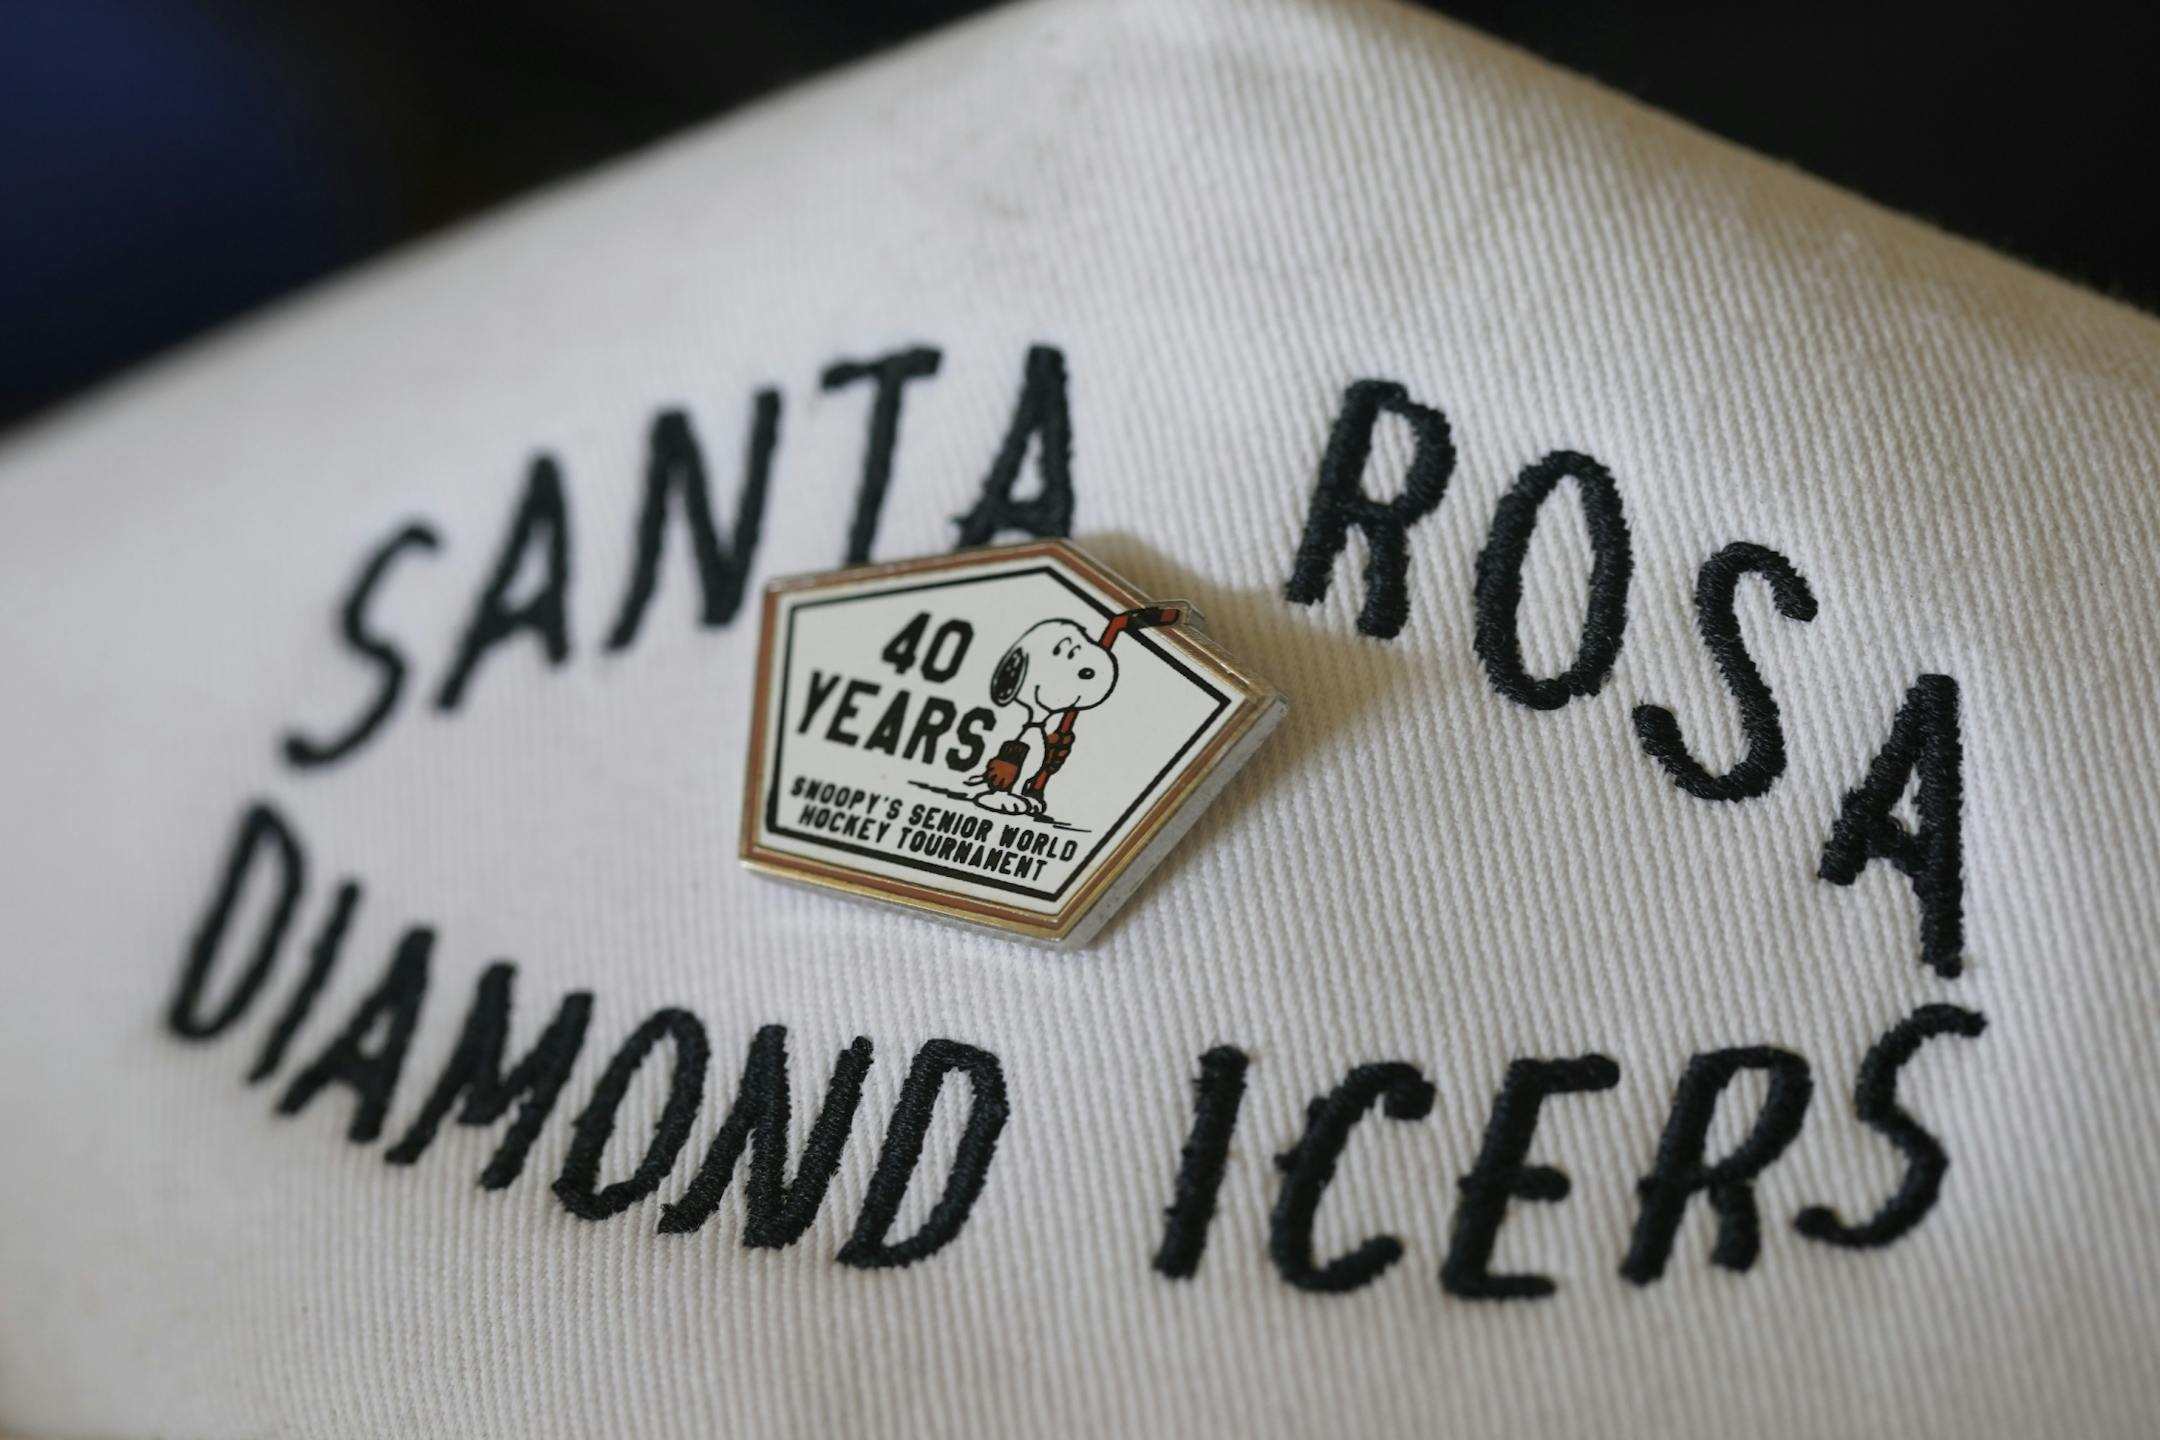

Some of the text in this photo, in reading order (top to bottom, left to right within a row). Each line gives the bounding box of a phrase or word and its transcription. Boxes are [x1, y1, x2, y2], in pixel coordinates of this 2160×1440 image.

[282, 344, 1075, 770] SANTA
[881, 611, 974, 684] 40
[797, 670, 997, 773] YEARS
[1282, 378, 1966, 981] ROSA
[790, 776, 1078, 862] SNOOPY'S SENIOR WORLD
[798, 804, 1049, 882] HOCKEY TOURNAMENT
[166, 803, 1011, 1273] DIAMOND
[1150, 1001, 1989, 1306] ICERS
